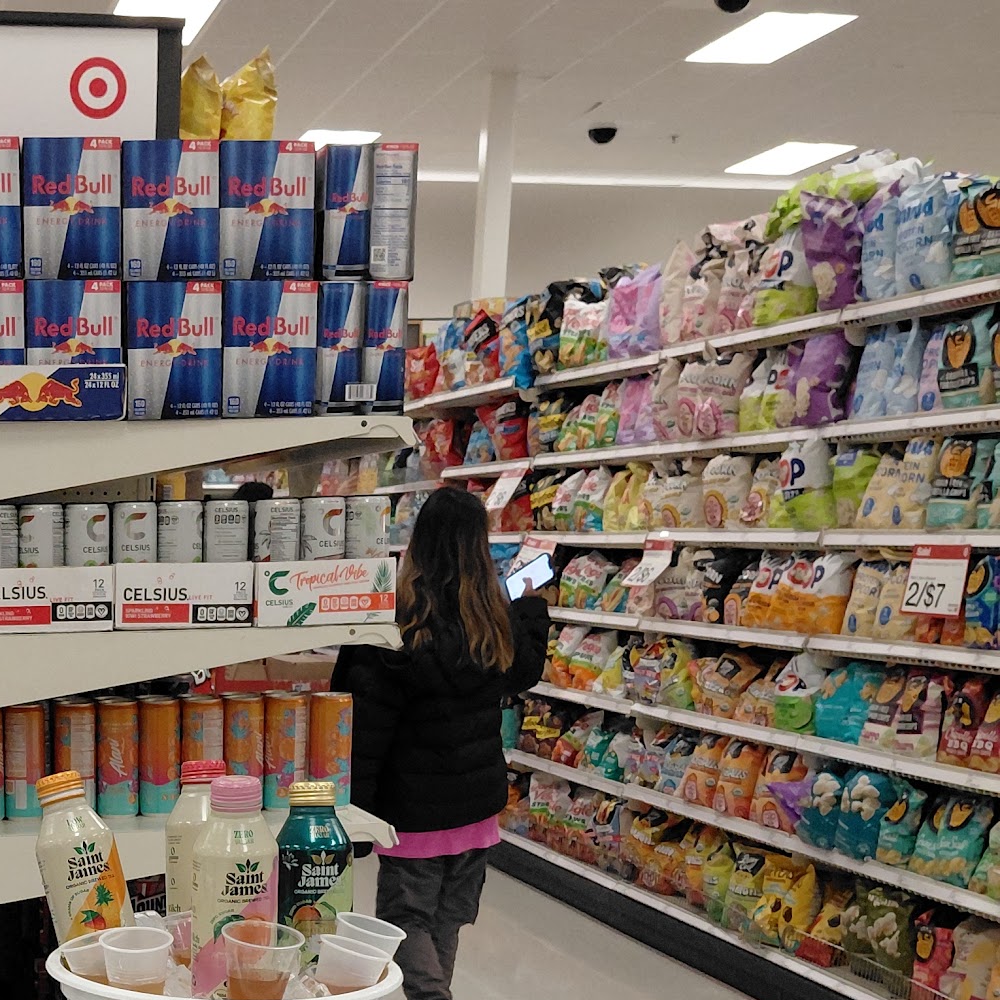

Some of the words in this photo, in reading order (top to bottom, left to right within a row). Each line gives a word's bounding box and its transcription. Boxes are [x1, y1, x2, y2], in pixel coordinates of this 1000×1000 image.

[228, 176, 266, 197] Red
[270, 176, 306, 196] Bull
[232, 316, 270, 337] Red
[274, 316, 309, 336] Bull
[93, 578, 104, 589] 12
[235, 581, 246, 591] 12
[905, 581, 946, 608] 2/$7
[234, 830, 253, 838] ZERO
[68, 851, 103, 869] Saint
[68, 861, 110, 881] James
[226, 870, 264, 885] Saint
[302, 864, 339, 876] Saint
[221, 884, 267, 896] James
